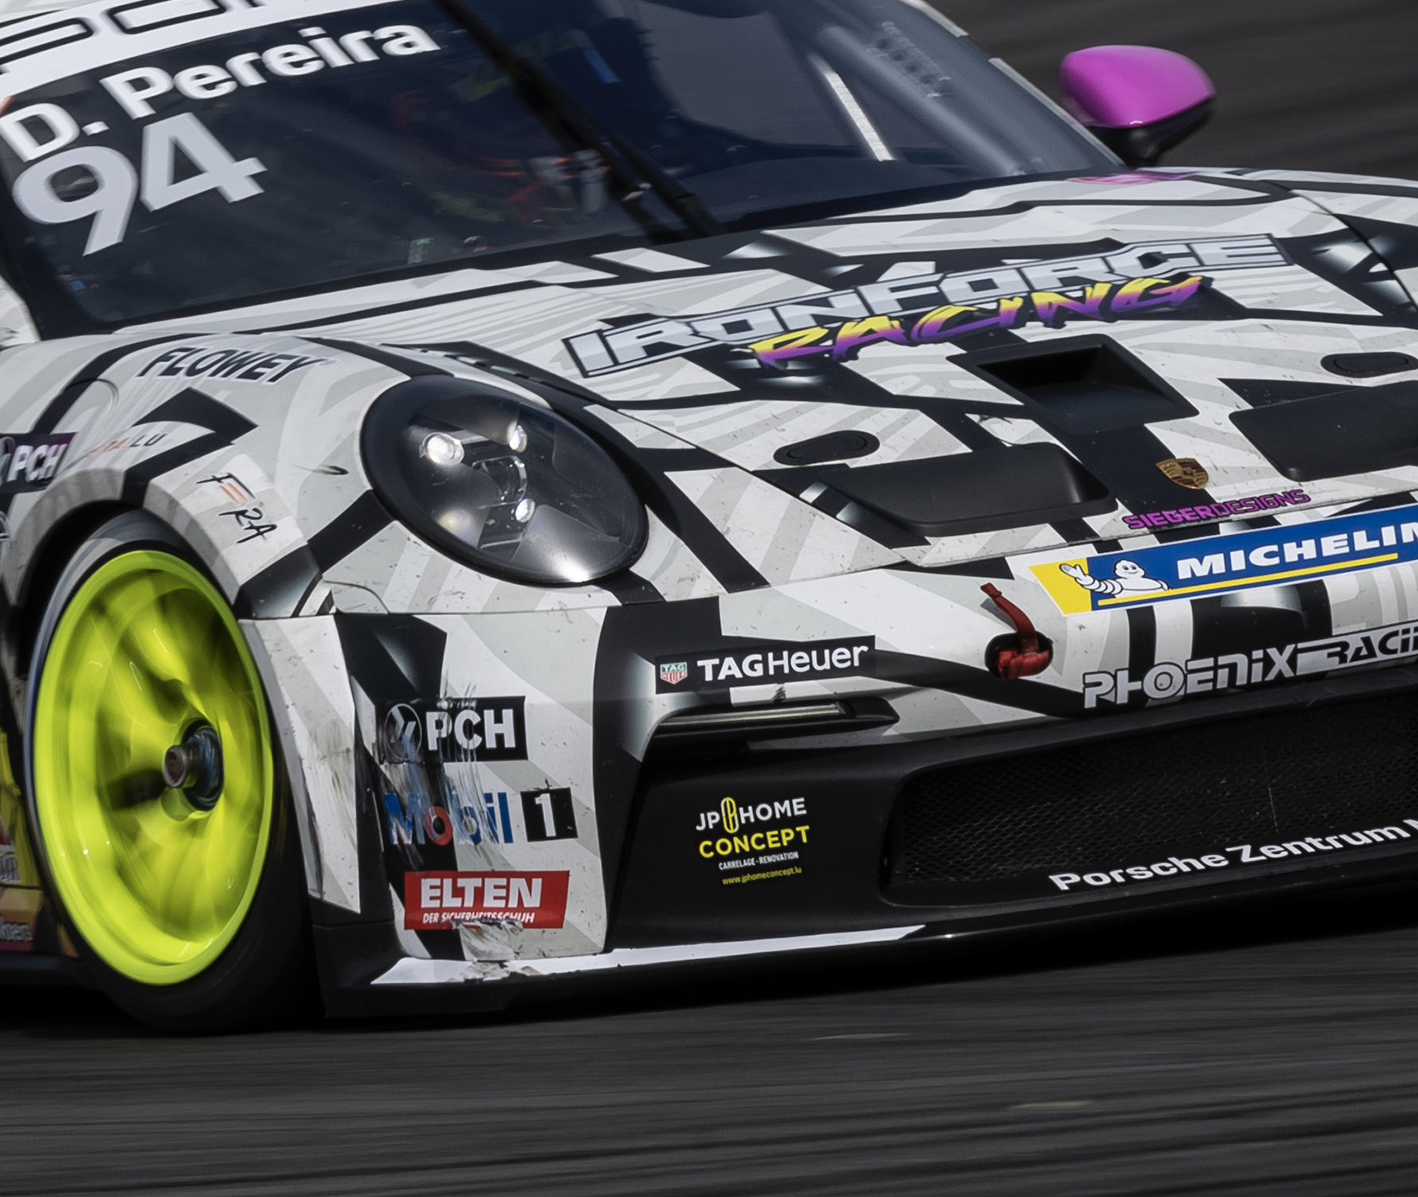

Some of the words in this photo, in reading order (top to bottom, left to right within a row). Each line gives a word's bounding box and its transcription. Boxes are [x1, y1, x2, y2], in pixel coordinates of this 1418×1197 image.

[99, 24, 441, 120] Pereira
[12, 111, 268, 257] 94
[566, 235, 1291, 377] IRONFORCE
[747, 274, 1204, 369] RACING
[137, 346, 324, 383] FLOWEY
[6, 444, 69, 483] PCH
[1122, 488, 1311, 531] SIEGERDESIGNS
[425, 708, 517, 751] PCH
[382, 790, 515, 846] Mobil
[534, 792, 557, 837] 1
[696, 811, 721, 831] JP
[739, 797, 808, 824] HOME
[699, 825, 811, 859] CONCEPT
[1048, 851, 1230, 891] Porsche
[1225, 822, 1411, 864] Zentrum
[421, 877, 543, 909] ELTEN
[422, 912, 440, 924] DER
